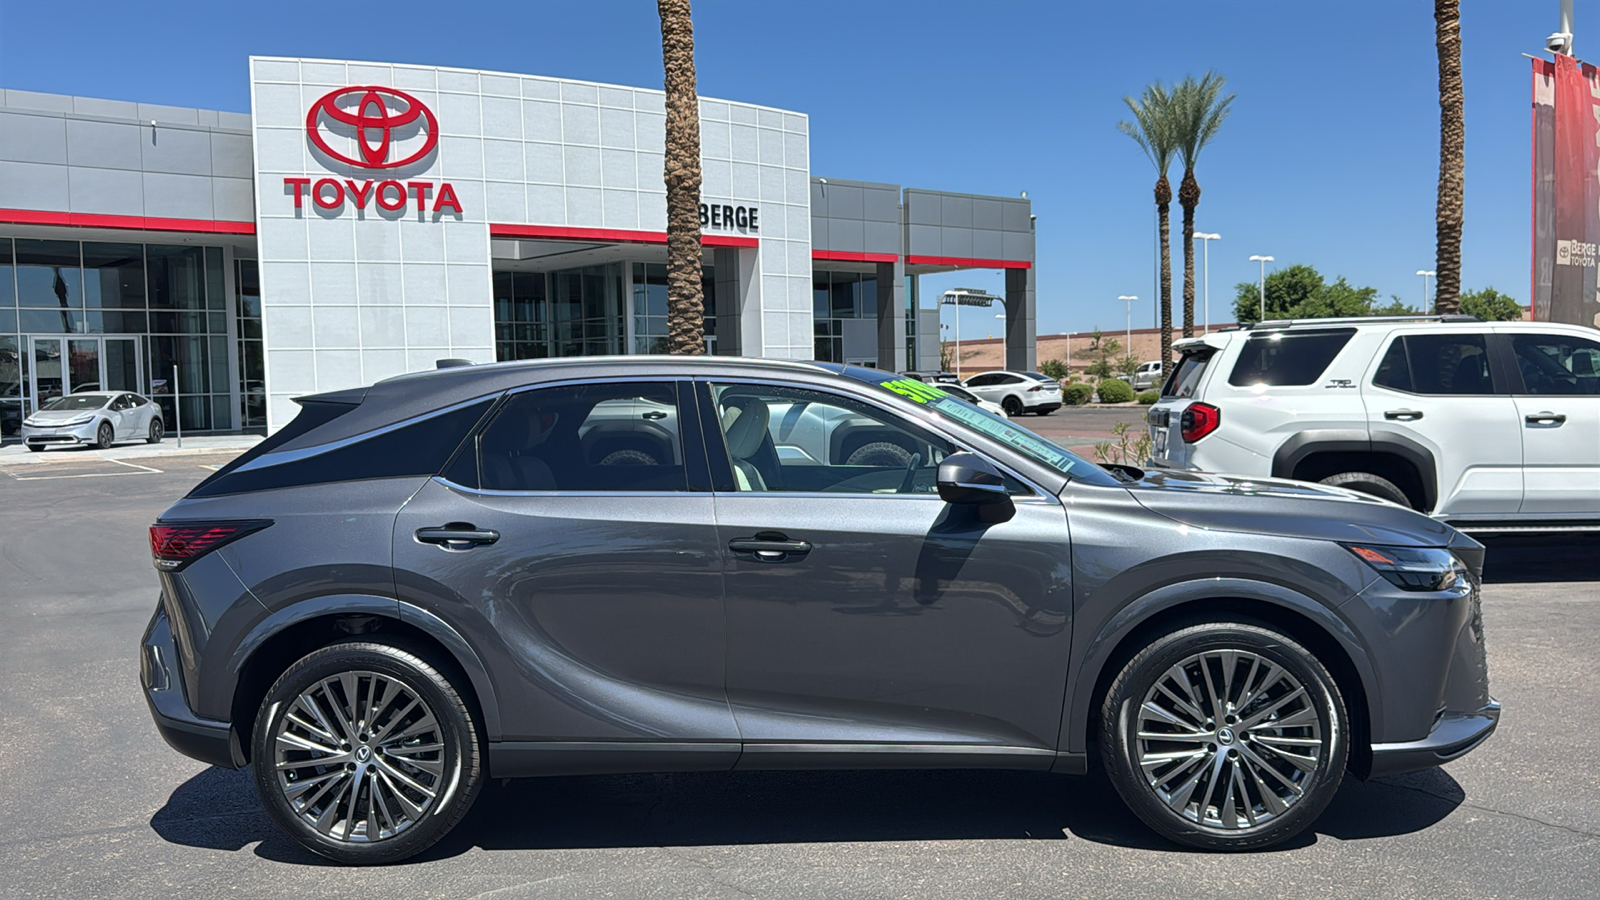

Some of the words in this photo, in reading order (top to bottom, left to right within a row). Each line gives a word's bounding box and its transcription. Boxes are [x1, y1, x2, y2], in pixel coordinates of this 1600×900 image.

[283, 177, 464, 213] TOYOTA
[700, 203, 759, 229] BERGE
[1571, 239, 1596, 257] BERGE
[1571, 256, 1596, 268] TOYOTA
